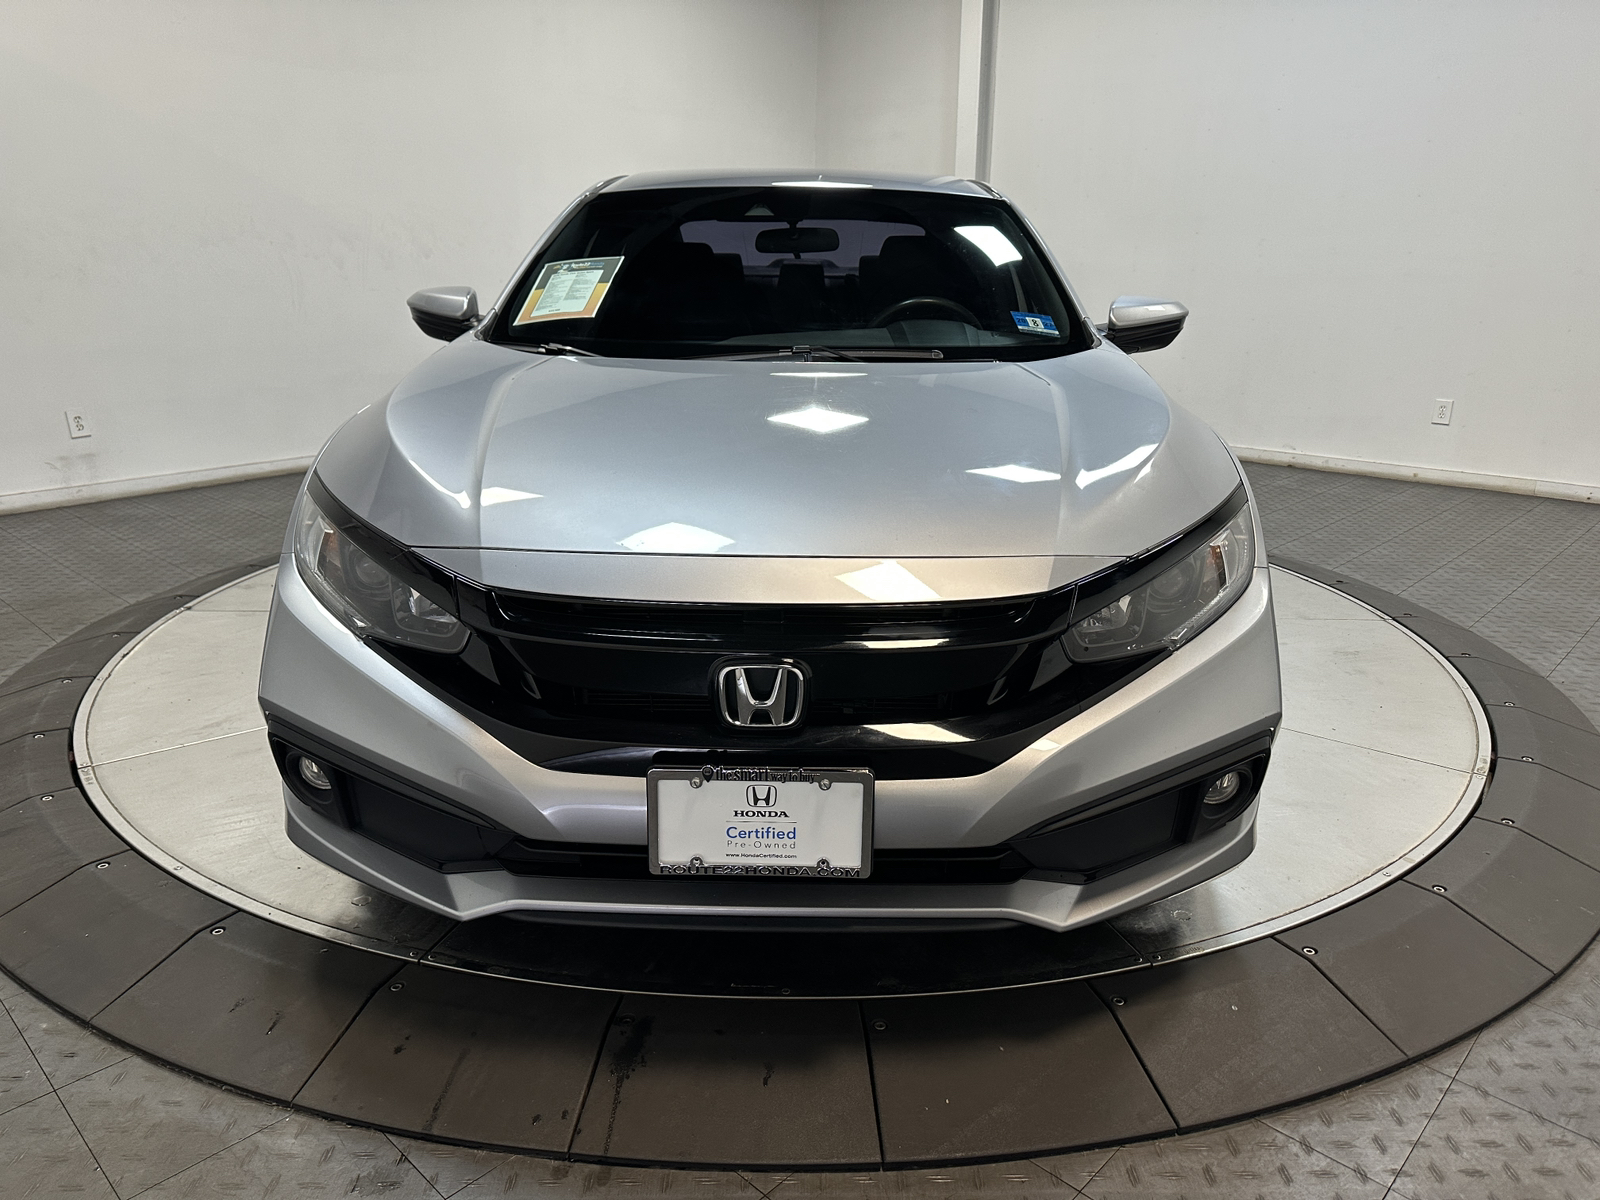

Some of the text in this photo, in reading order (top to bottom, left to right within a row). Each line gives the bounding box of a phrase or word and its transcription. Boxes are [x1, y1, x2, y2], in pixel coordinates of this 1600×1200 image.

[1031, 318, 1039, 327] 8
[733, 810, 790, 818] HONDA
[726, 826, 797, 840] Certified
[726, 840, 797, 850] Pre-Owned
[659, 864, 861, 878] ROUTE22HONDA.COM
